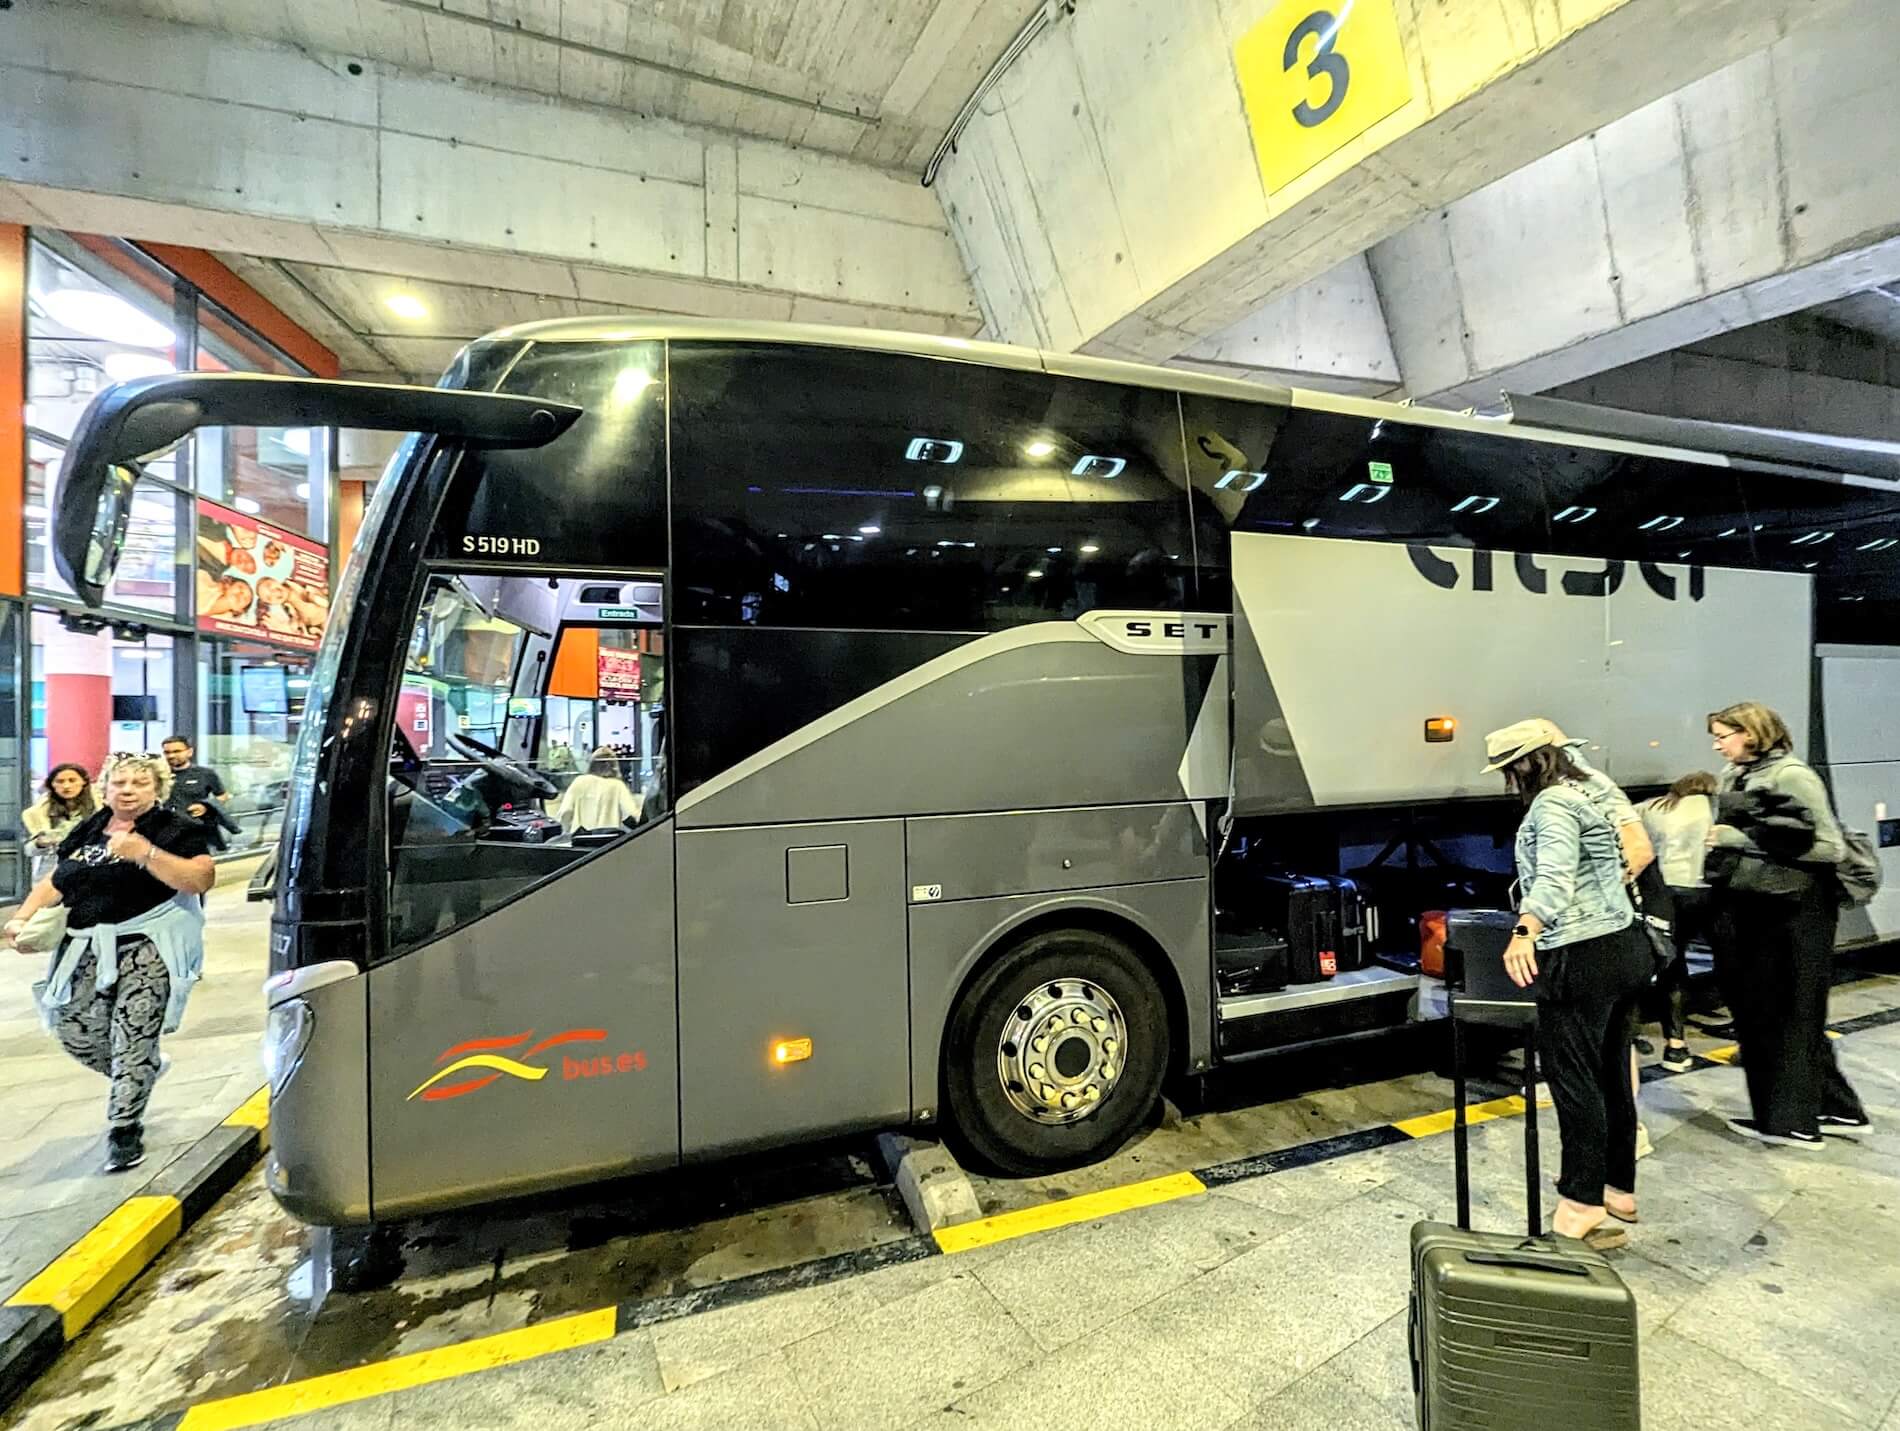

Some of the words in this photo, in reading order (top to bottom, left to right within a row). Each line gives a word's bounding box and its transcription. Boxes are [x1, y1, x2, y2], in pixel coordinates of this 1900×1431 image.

[1283, 10, 1350, 128] 3
[462, 535, 476, 552] S
[478, 536, 509, 553] 519
[511, 538, 541, 555] HD
[1126, 622, 1234, 640] SET
[562, 1051, 649, 1081] bus.es
